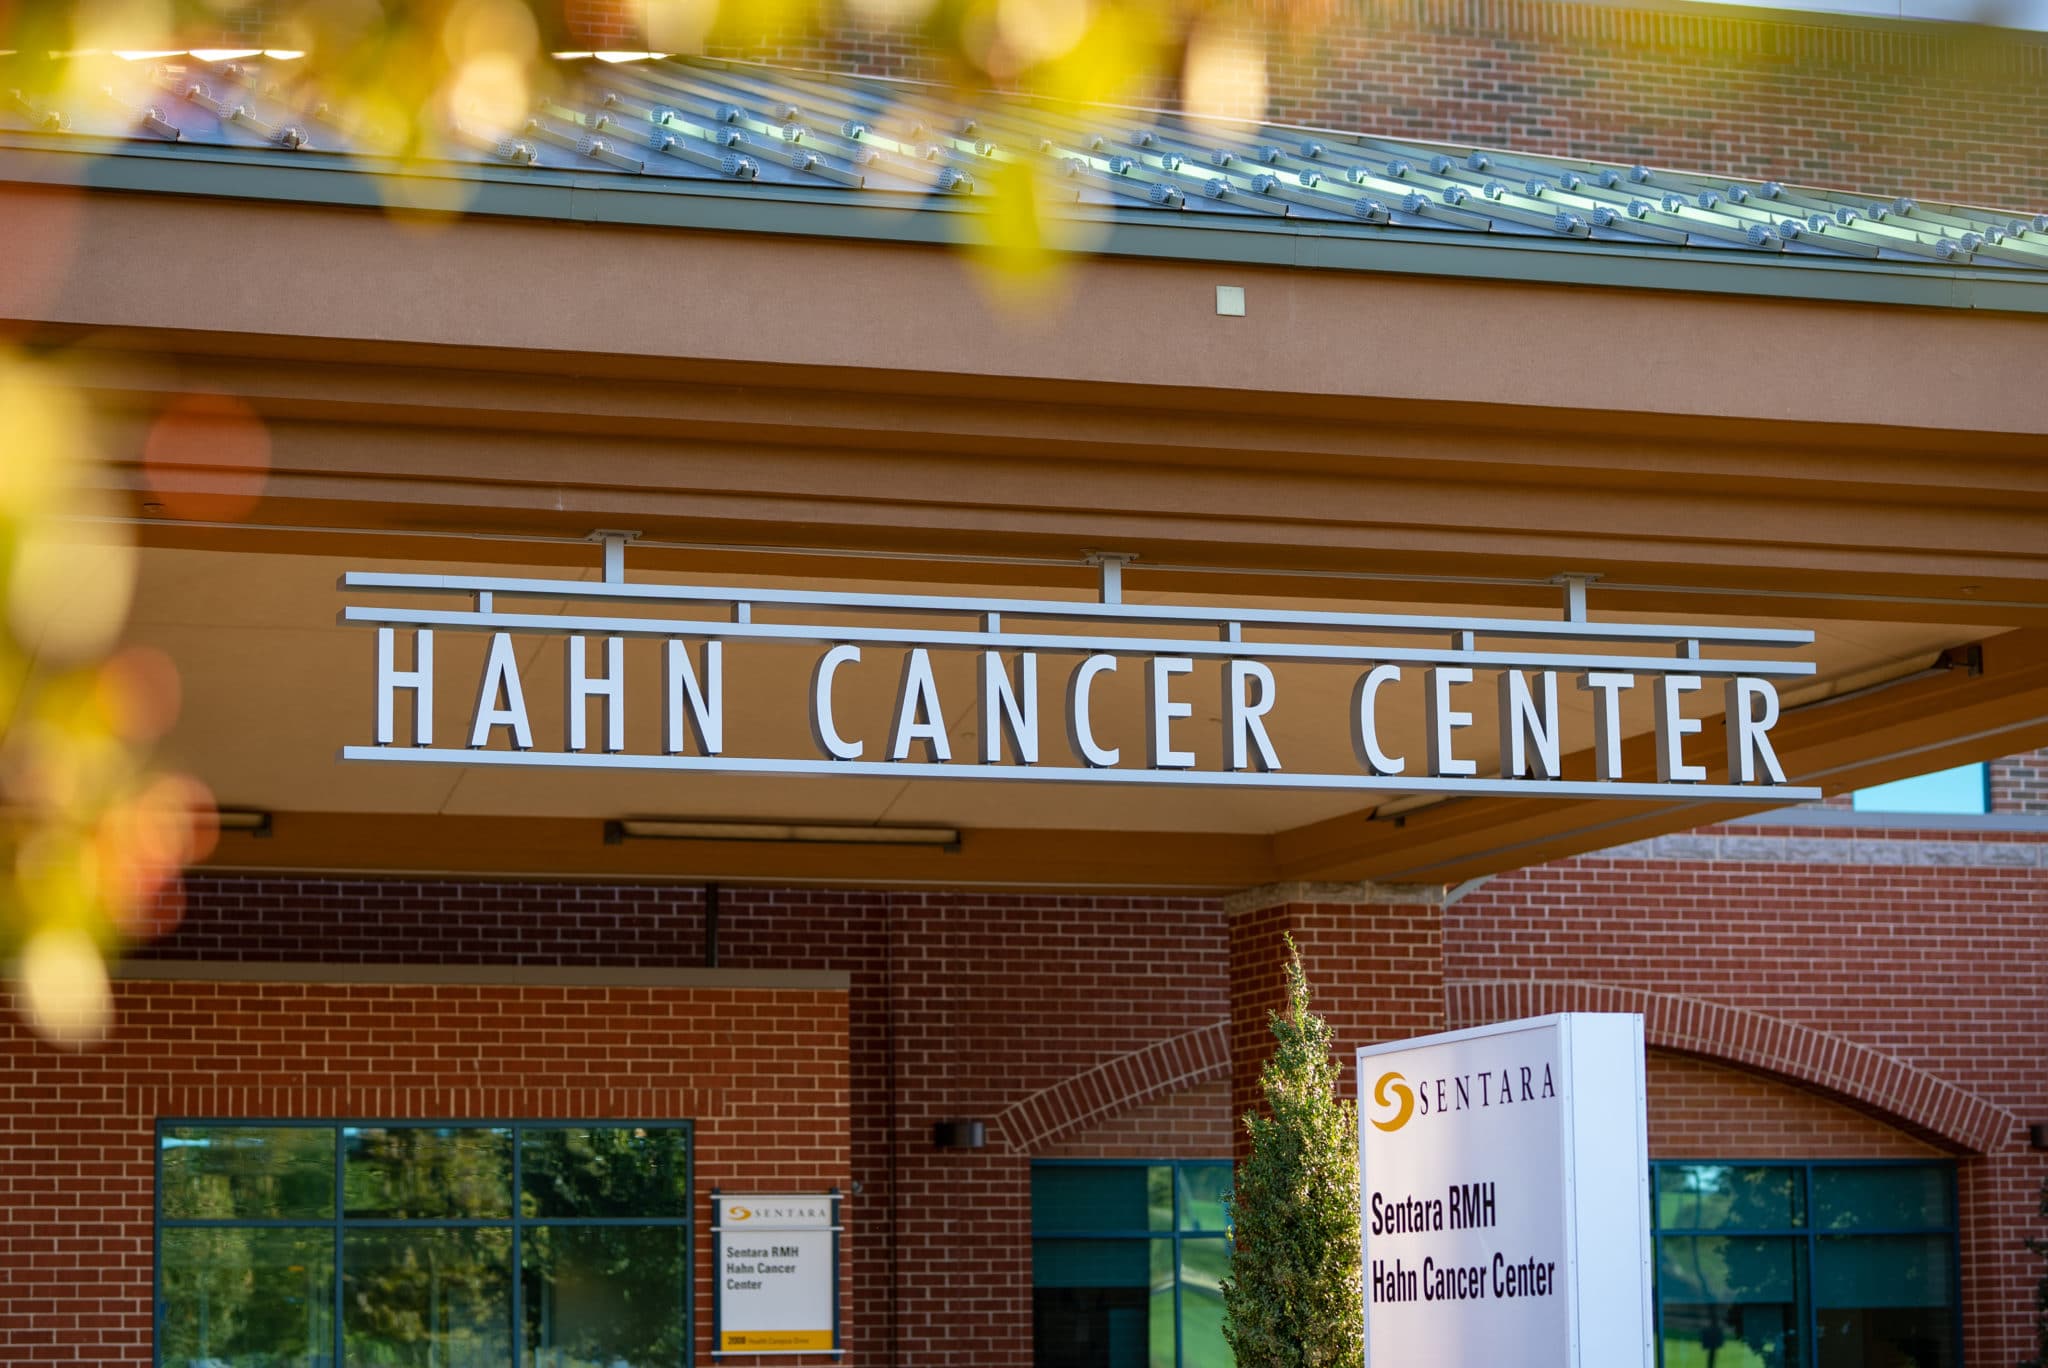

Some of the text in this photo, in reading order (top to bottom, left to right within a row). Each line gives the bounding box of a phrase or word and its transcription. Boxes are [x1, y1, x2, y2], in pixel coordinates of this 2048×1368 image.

[376, 627, 1788, 786] HAHN CANCER CENTER
[1419, 1062, 1556, 1115] SENTARA
[754, 1208, 827, 1218] SENTARA
[1371, 1181, 1497, 1236] Sentara RMH
[726, 1247, 799, 1258] Sentara RMH
[726, 1263, 797, 1274] Hahn Cancer
[1372, 1251, 1556, 1303] Hahn Cancer Center
[726, 1279, 763, 1290] Center
